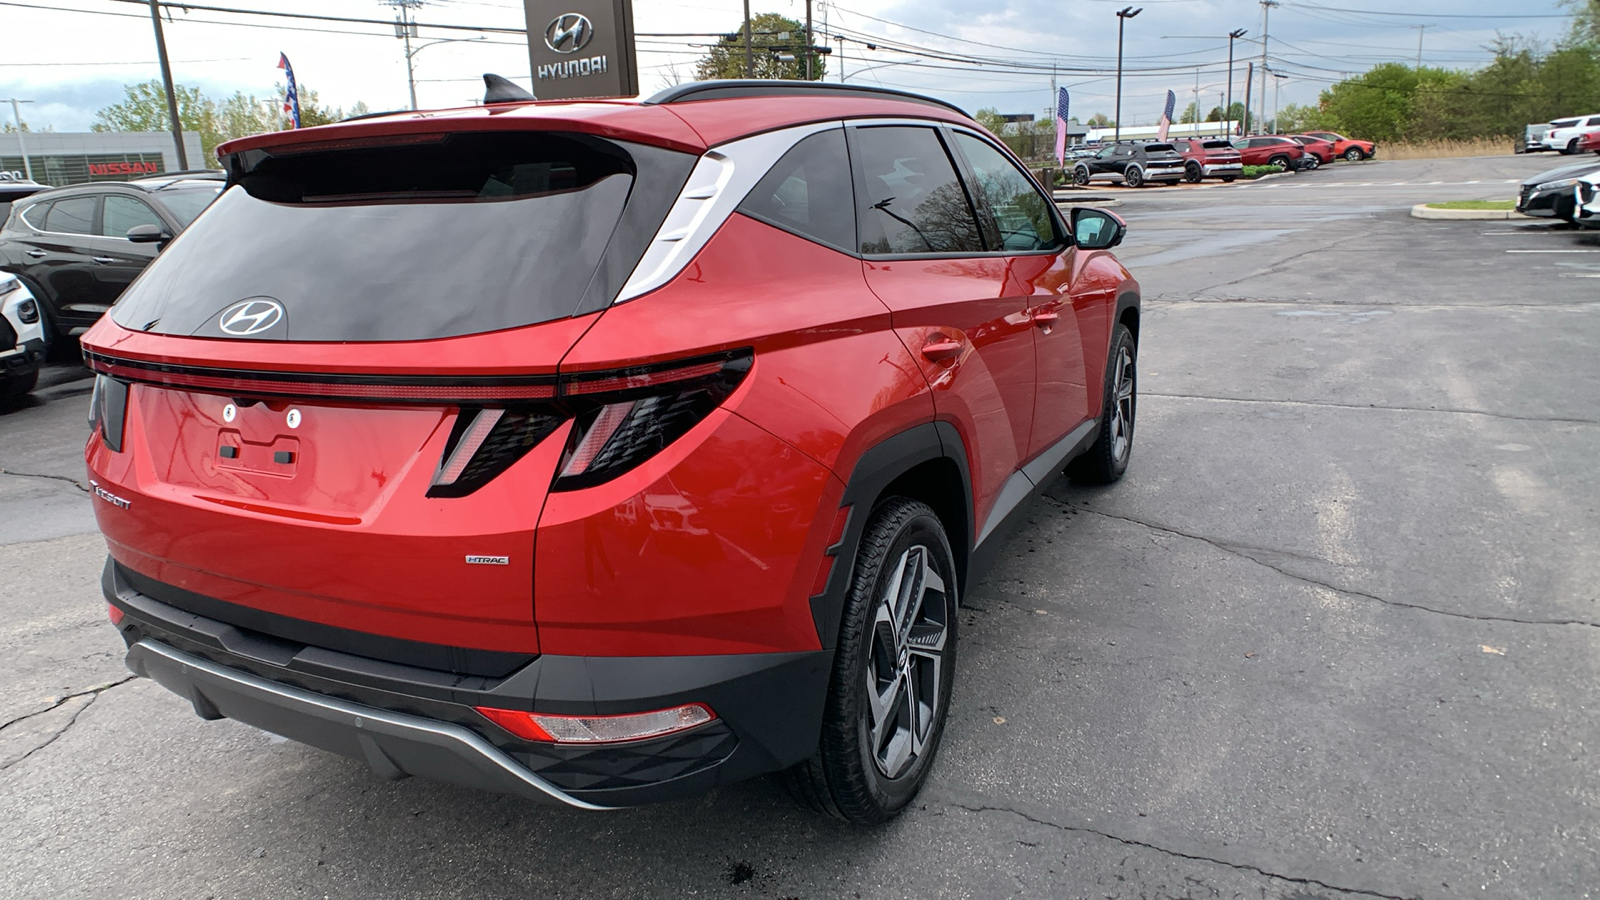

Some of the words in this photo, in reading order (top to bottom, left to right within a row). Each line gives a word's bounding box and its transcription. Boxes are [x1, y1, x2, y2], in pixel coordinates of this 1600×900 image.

[537, 55, 607, 80] HYUNDAI
[89, 161, 158, 175] NISSAN
[467, 556, 507, 564] HTRAC
